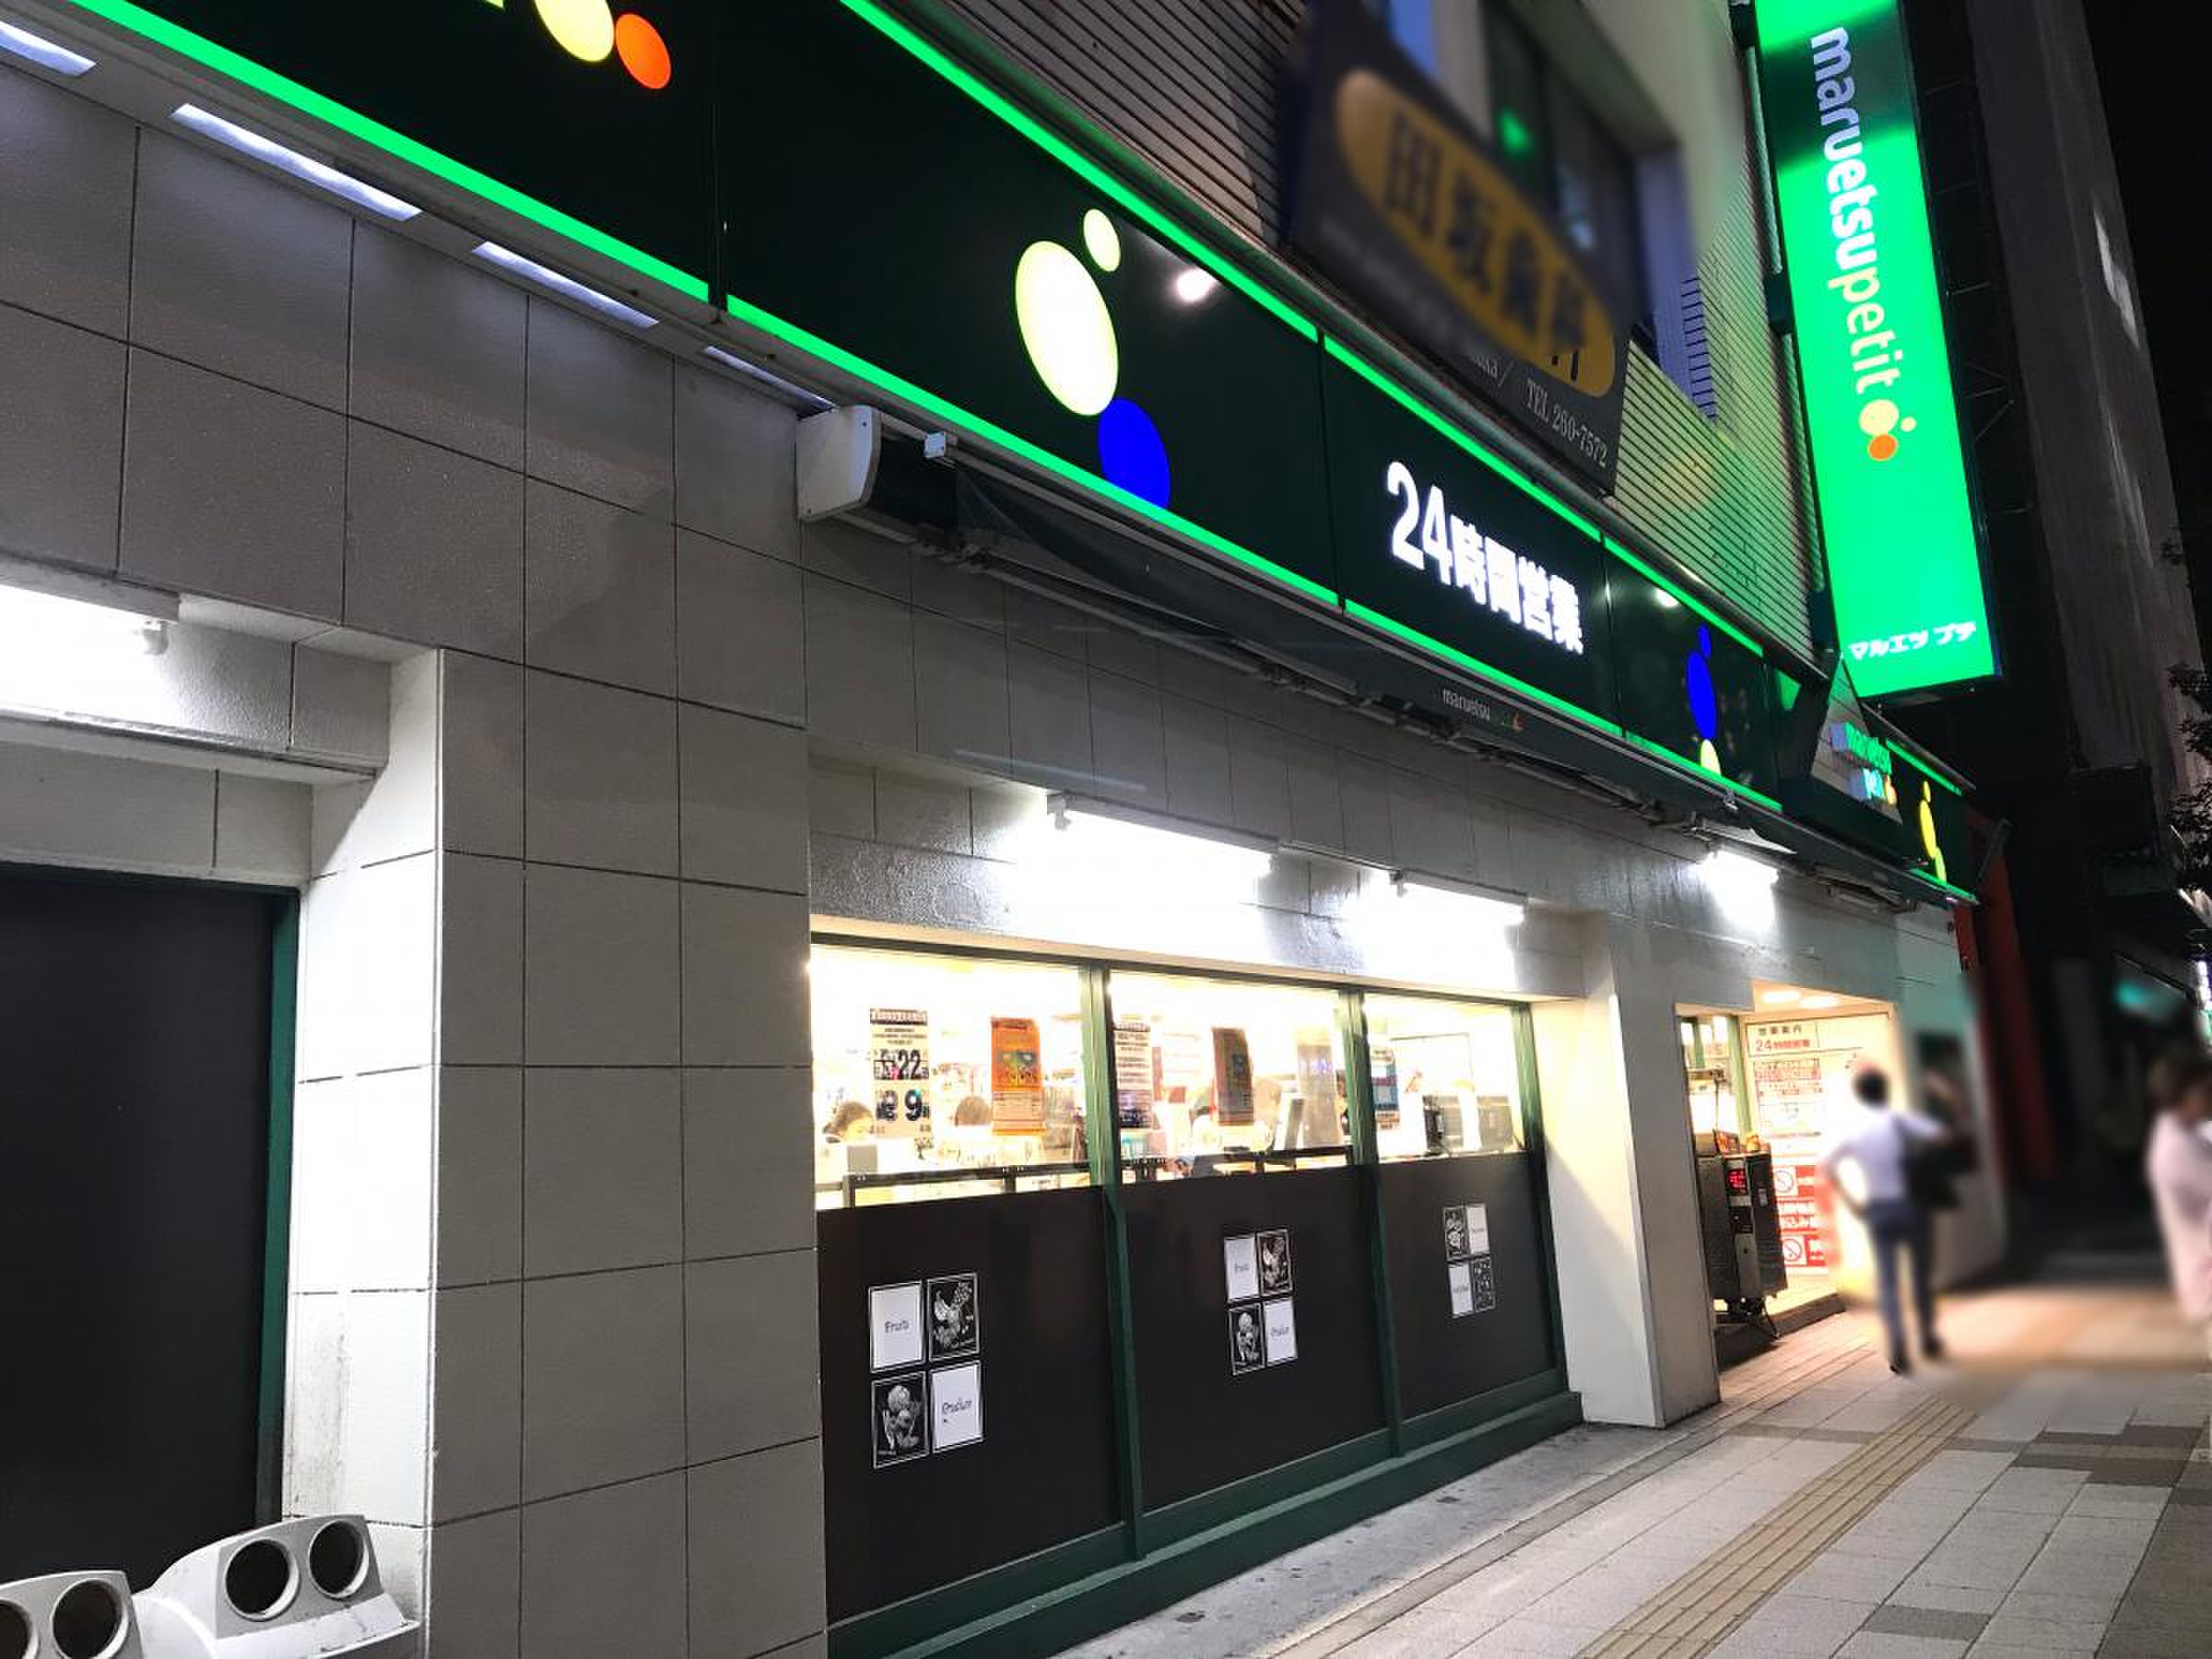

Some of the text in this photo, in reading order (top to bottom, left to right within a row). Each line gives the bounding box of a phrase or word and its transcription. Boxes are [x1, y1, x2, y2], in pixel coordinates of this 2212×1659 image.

[1526, 377, 1549, 422] TEL
[1386, 461, 1584, 655] 24時間営業
